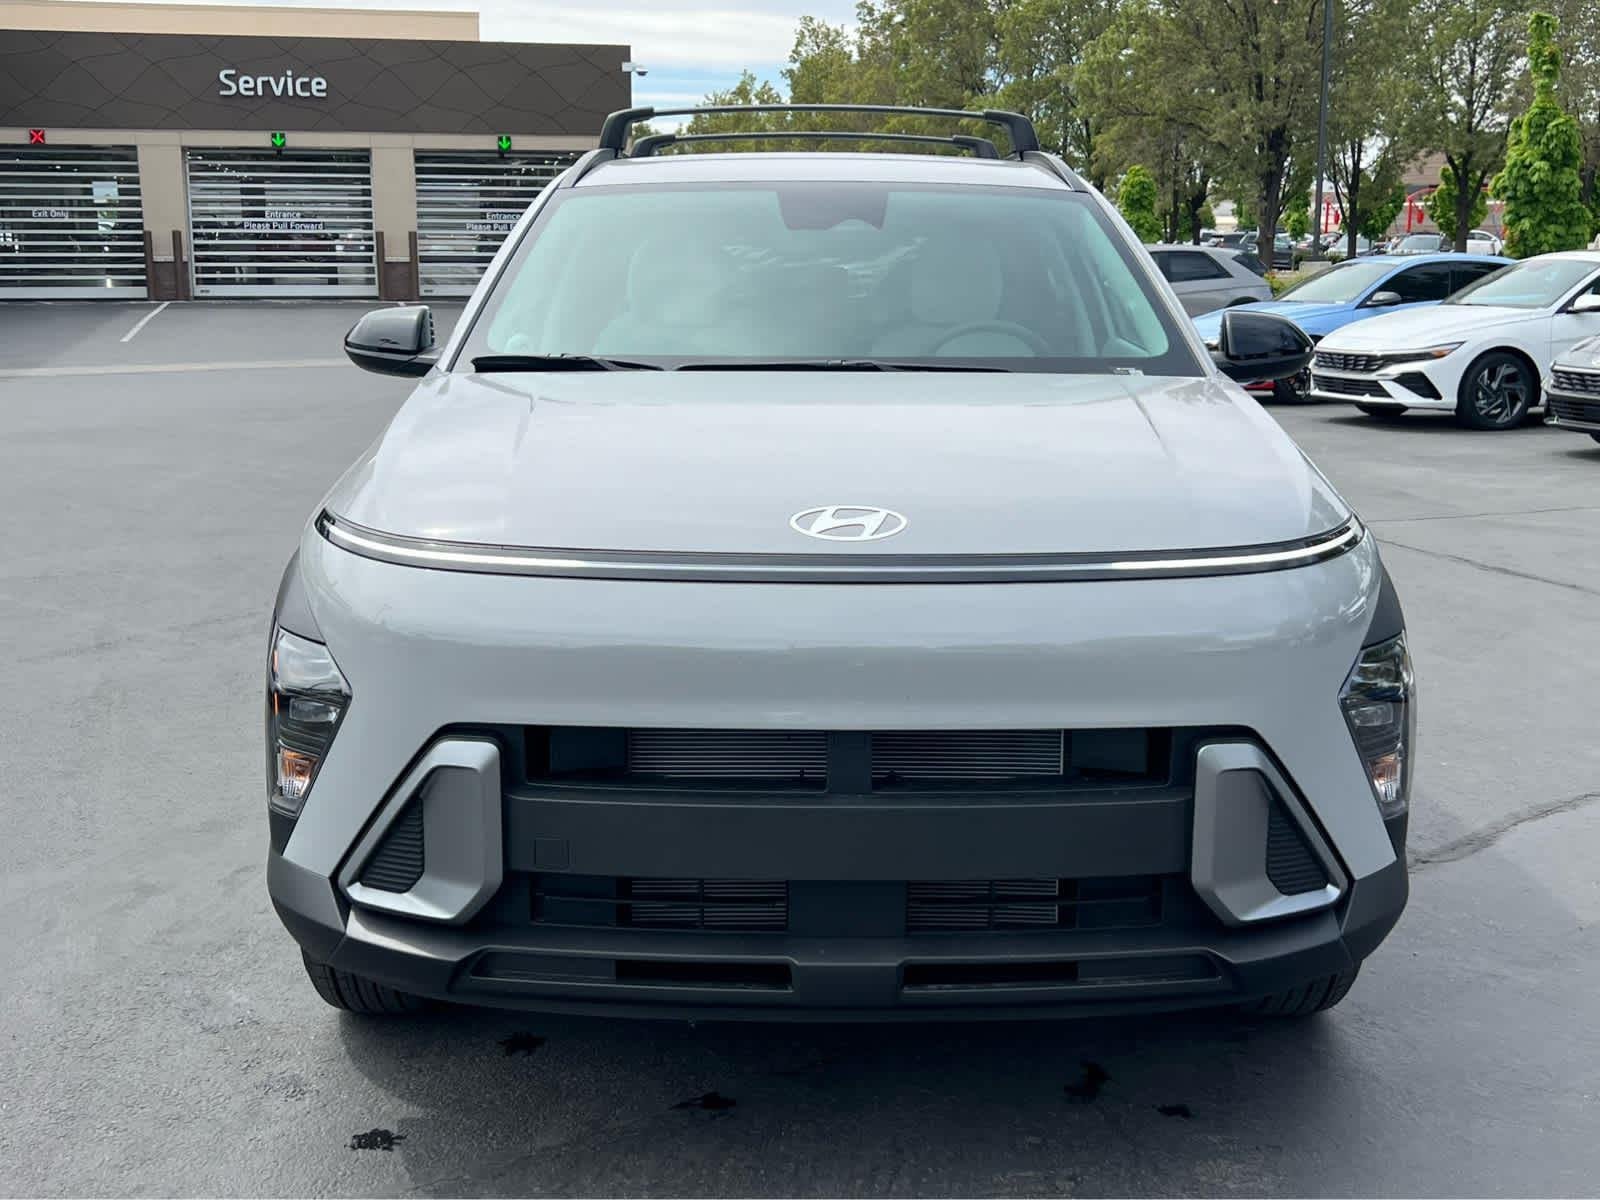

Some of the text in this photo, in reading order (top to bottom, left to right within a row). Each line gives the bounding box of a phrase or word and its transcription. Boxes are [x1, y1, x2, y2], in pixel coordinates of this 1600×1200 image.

[219, 69, 327, 97] Service
[32, 208, 69, 220] Exit Only
[265, 210, 301, 218] Entrance
[486, 212, 521, 221] Entrance
[243, 220, 323, 230] Please Pull Forward
[465, 222, 492, 232] Please
[493, 222, 509, 232] Pull
